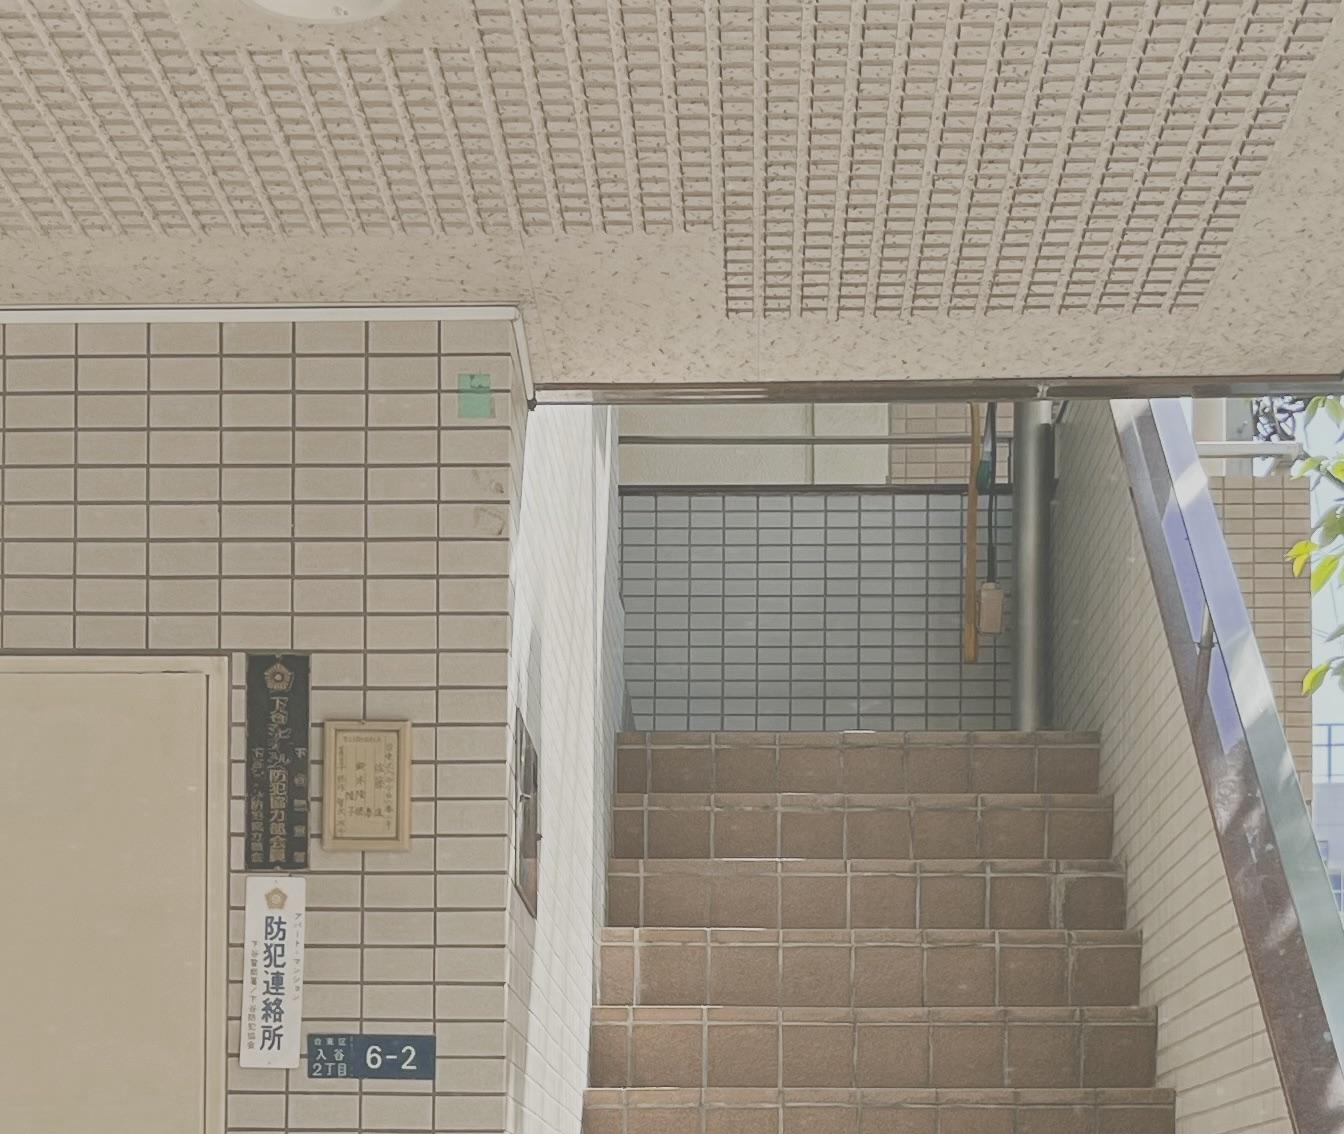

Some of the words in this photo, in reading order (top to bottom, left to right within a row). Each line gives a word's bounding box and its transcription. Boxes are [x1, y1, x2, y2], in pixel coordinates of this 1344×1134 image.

[259, 915, 288, 1051] 防犯連絡所
[315, 1048, 345, 1062] 入谷
[365, 1045, 418, 1070] 6-2
[312, 1062, 347, 1077] 2丁目
